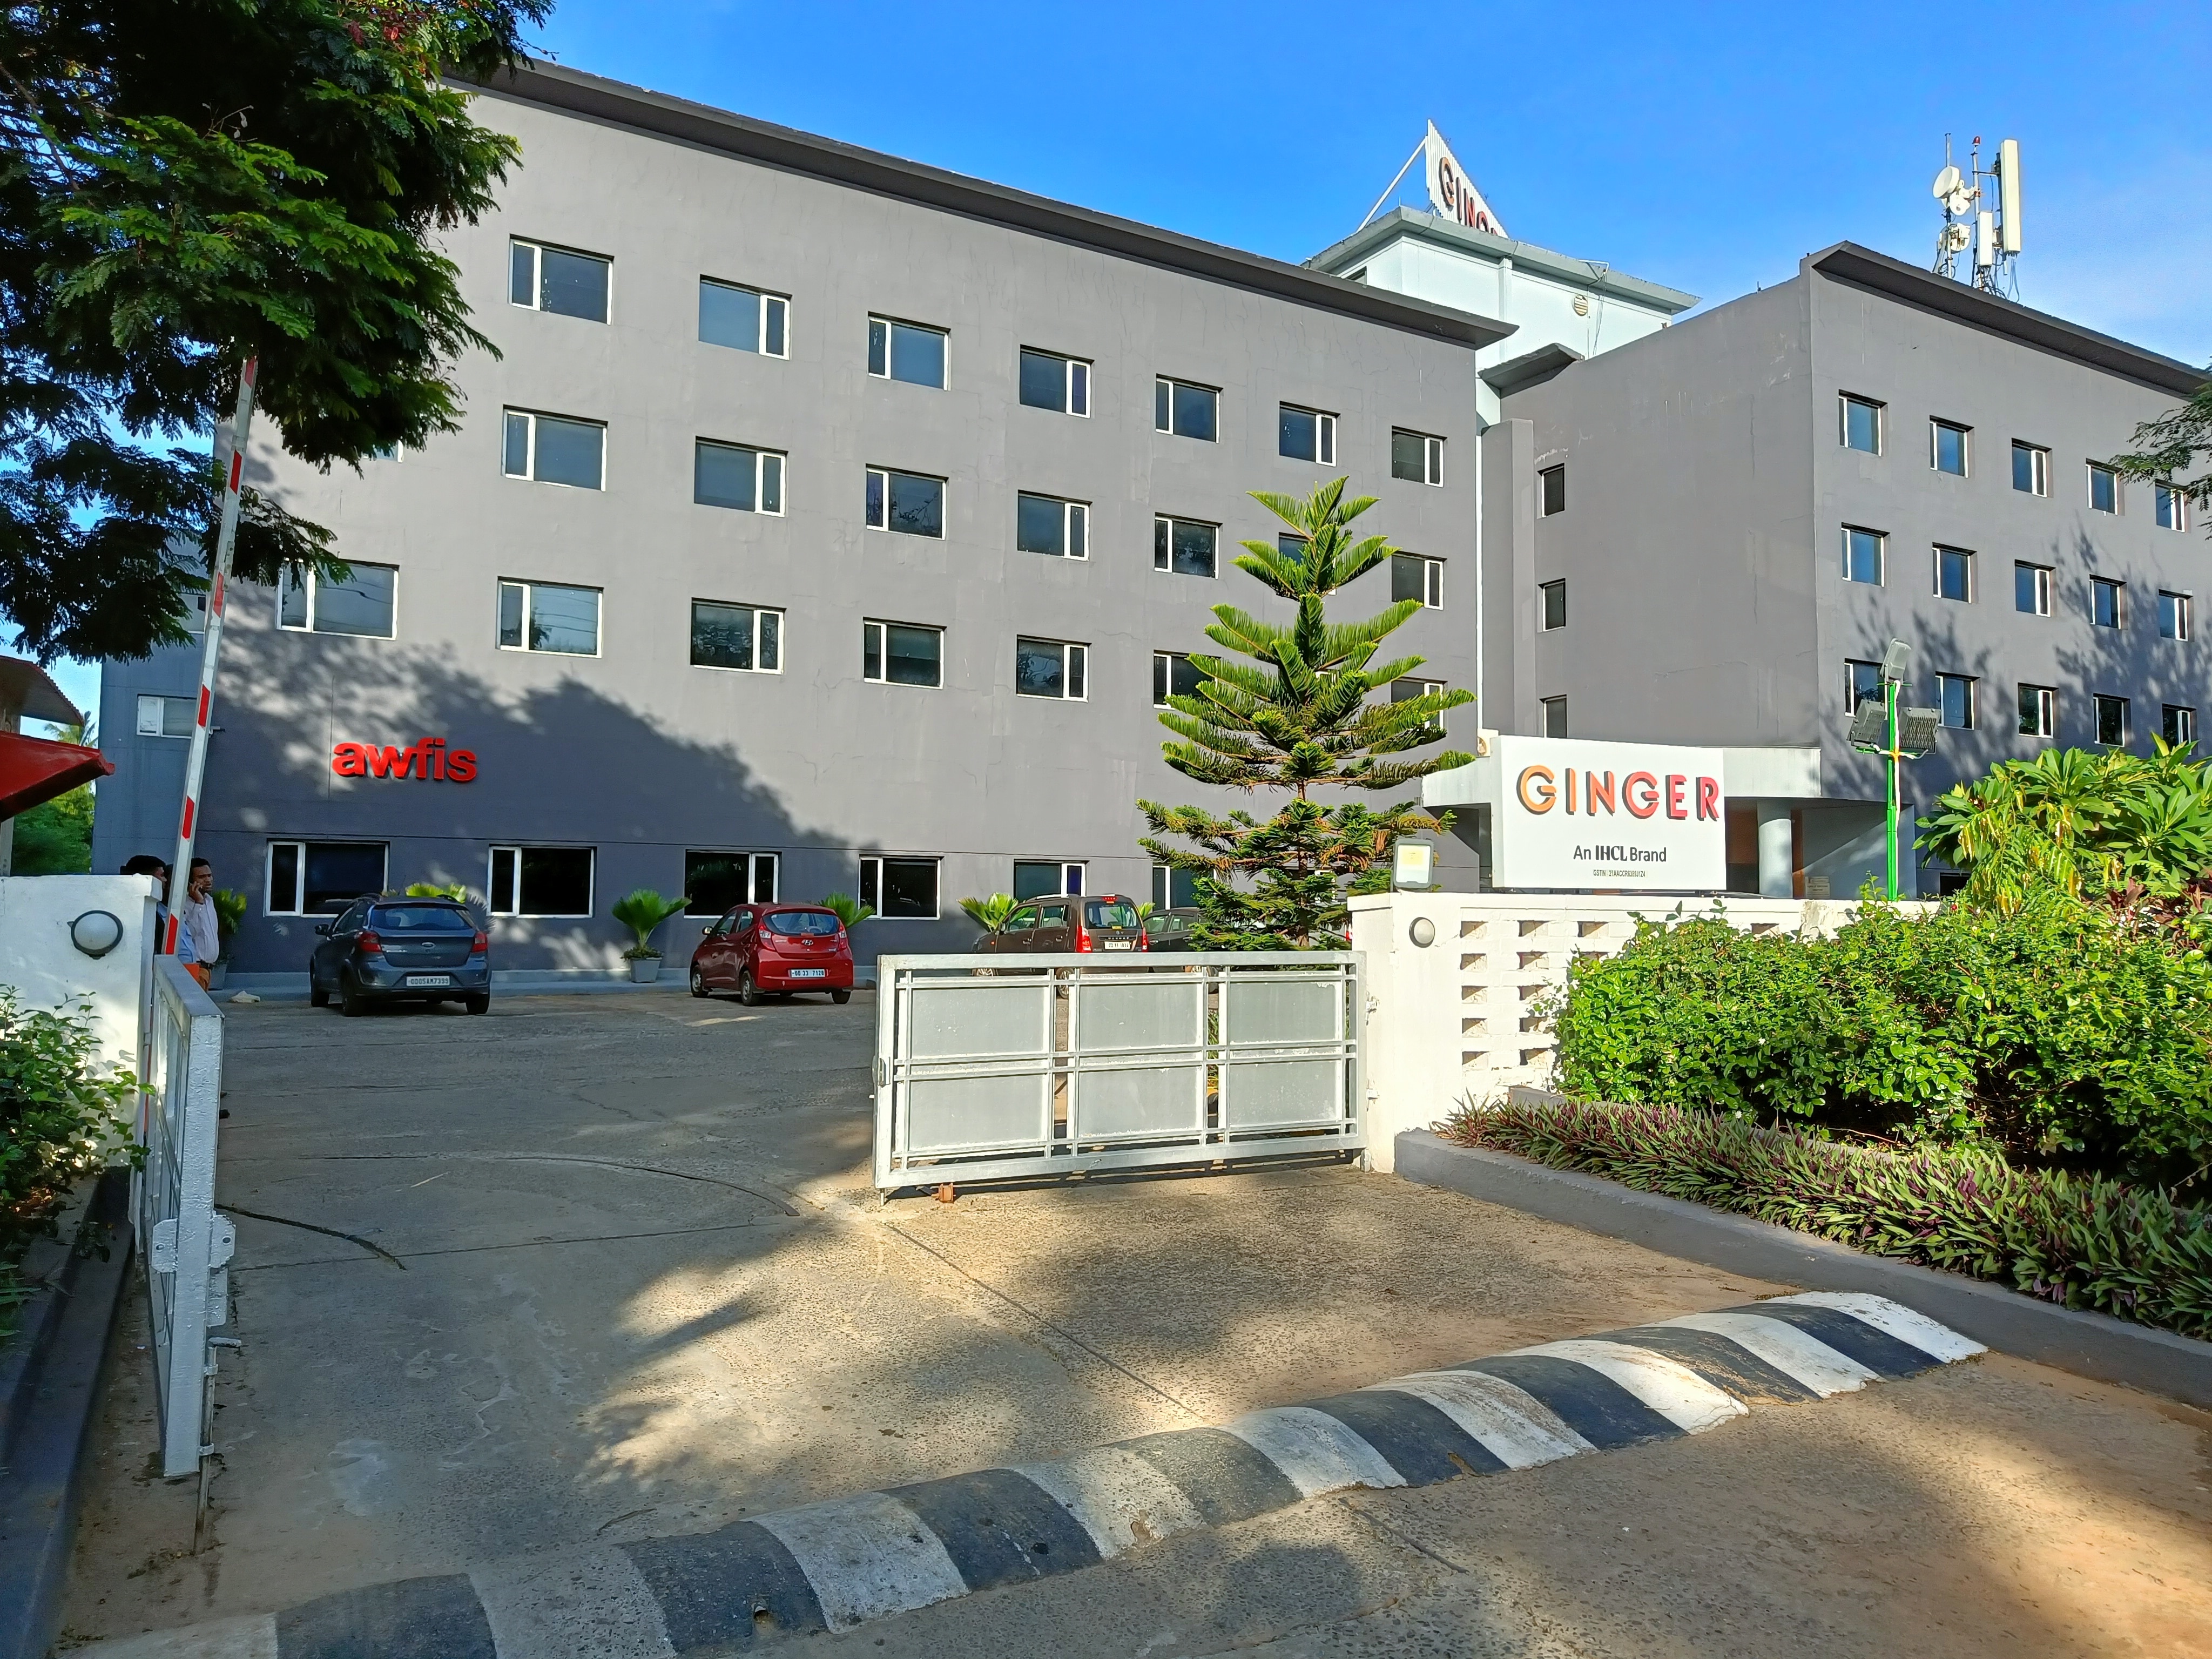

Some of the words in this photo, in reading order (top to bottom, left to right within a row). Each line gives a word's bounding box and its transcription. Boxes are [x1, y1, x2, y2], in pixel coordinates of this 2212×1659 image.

[332, 736, 477, 783] awfis
[1516, 765, 1720, 821] GINGER
[1573, 845, 1591, 860] An
[1595, 845, 1628, 861] IHCL
[1630, 847, 1667, 862] Brand
